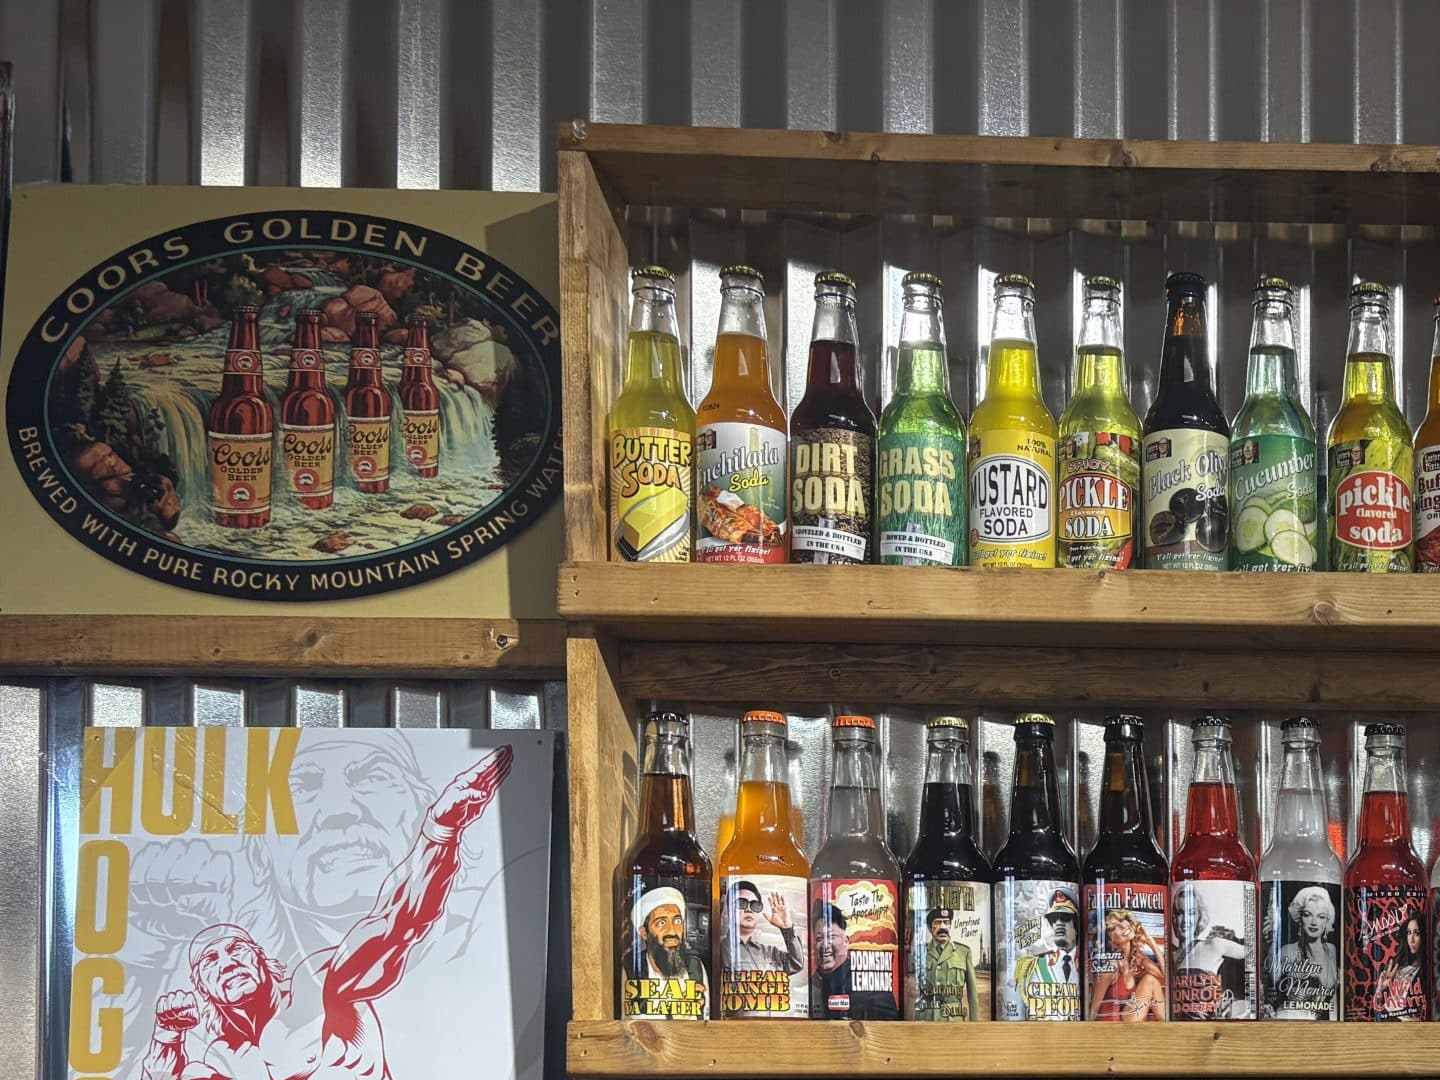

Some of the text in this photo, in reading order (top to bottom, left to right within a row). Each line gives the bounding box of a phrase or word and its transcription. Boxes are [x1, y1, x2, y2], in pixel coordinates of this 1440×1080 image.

[41, 218, 559, 346] COORS GOLDEN BEER
[211, 443, 270, 467] Coors
[611, 435, 692, 470] BUTTER
[796, 443, 858, 475] DIRT
[880, 447, 956, 479] GRASS
[220, 465, 263, 475] GOLDEN
[621, 465, 681, 498] SODA
[1234, 452, 1314, 501] Cucumber
[793, 477, 865, 514] SODA
[880, 481, 952, 516] SODA
[970, 464, 1047, 509] MUSTARD
[1059, 476, 1129, 510] PICKLE
[1339, 477, 1411, 515] pickle
[18, 426, 530, 590] BREWED WITH PURE ROCKY MOUNTAIN SPRING
[980, 508, 1033, 518] FLAVORED
[1356, 509, 1397, 519] flavored
[984, 519, 1027, 537] SODA
[1065, 517, 1114, 537] SODA
[1350, 524, 1403, 543] soda
[81, 728, 302, 835] HULK
[849, 891, 884, 908] Taste The
[1124, 888, 1164, 910] Fawcett
[851, 951, 893, 971] DOOMSDAY
[625, 978, 702, 1001] SEAL
[852, 972, 892, 991] LEMONADE
[650, 1001, 701, 1015] LATER
[1283, 1000, 1334, 1010] LEMONADE
